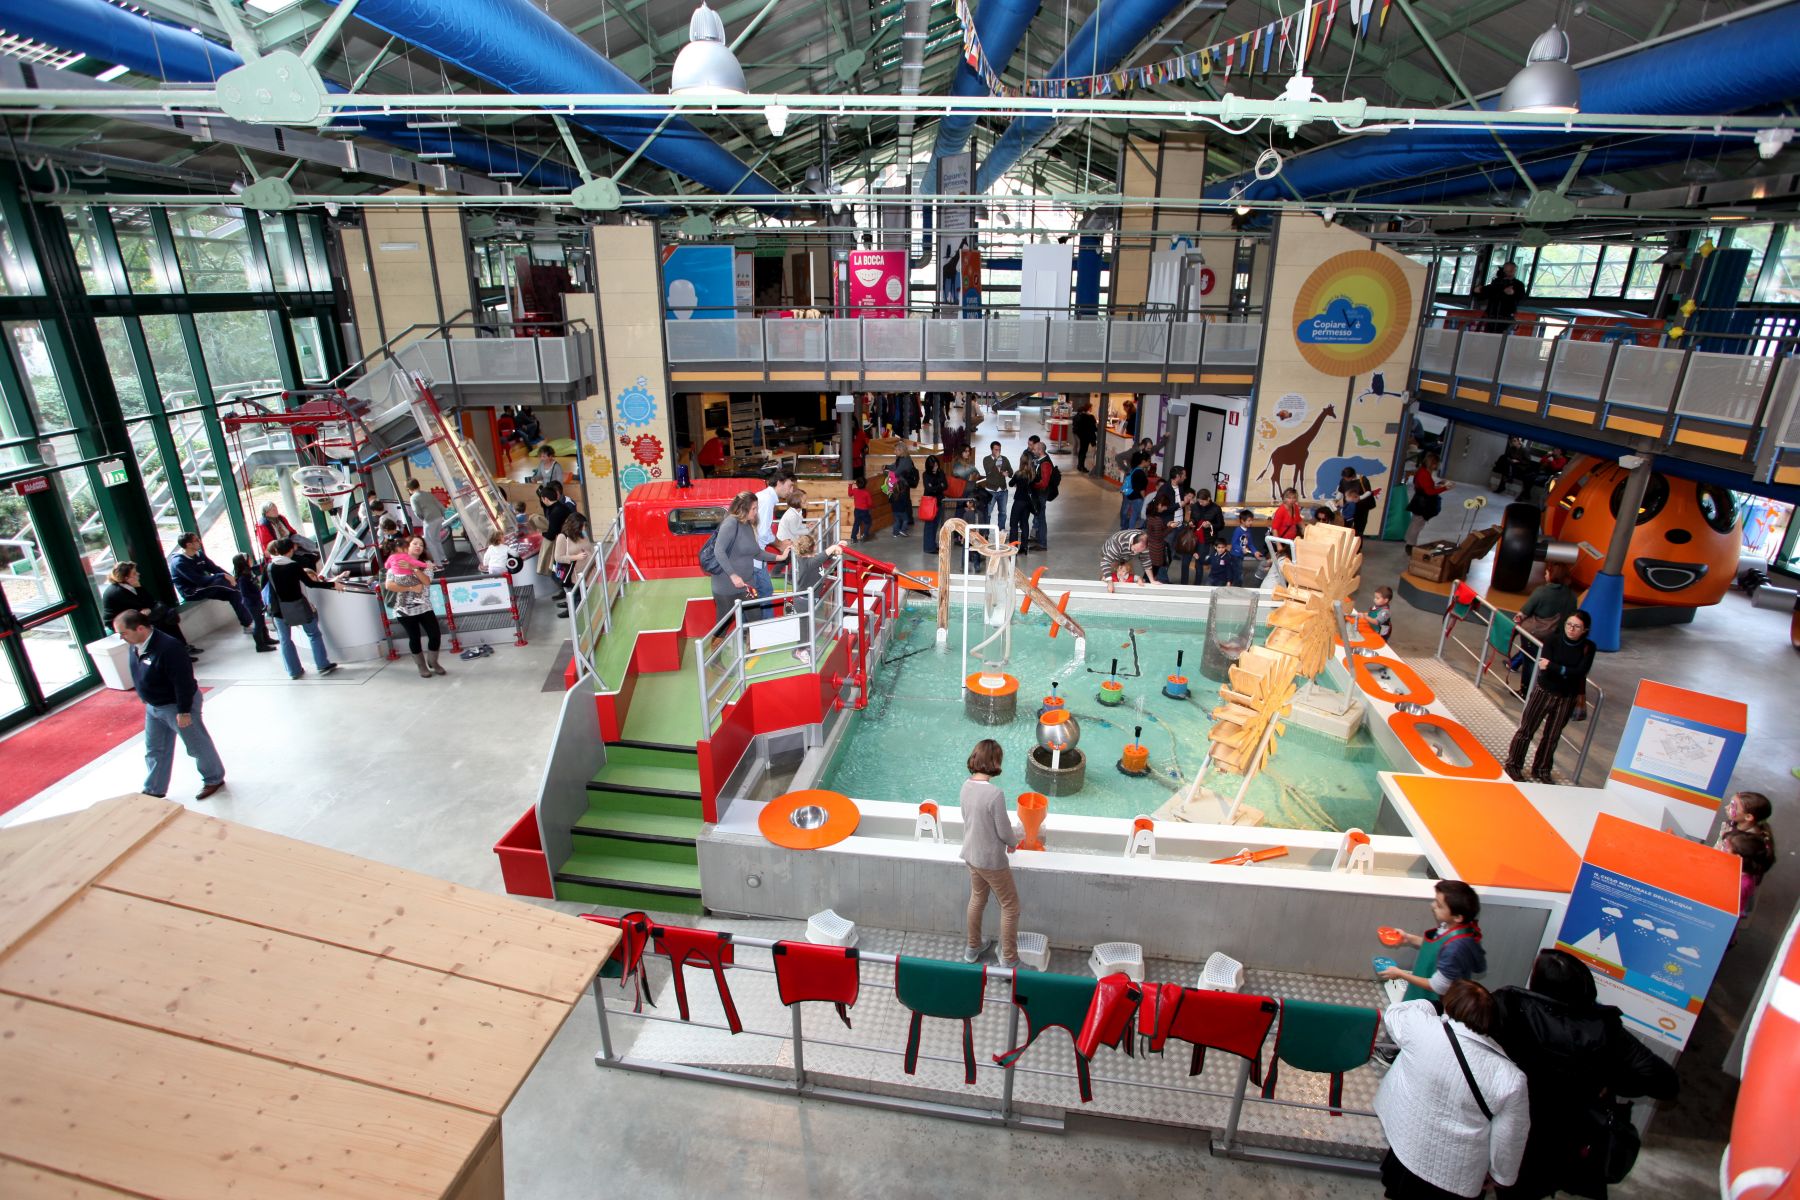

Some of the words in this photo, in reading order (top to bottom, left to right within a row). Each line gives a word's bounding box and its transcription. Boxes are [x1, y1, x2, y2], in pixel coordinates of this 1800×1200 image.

[854, 255, 862, 265] LA
[863, 255, 884, 265] BOCCA
[1313, 320, 1346, 330] Copiare
[1312, 329, 1352, 338] permesso
[1600, 874, 1618, 883] CICLO
[1618, 881, 1652, 896] NATURALE
[1652, 893, 1693, 911] DELL'ACQUA
